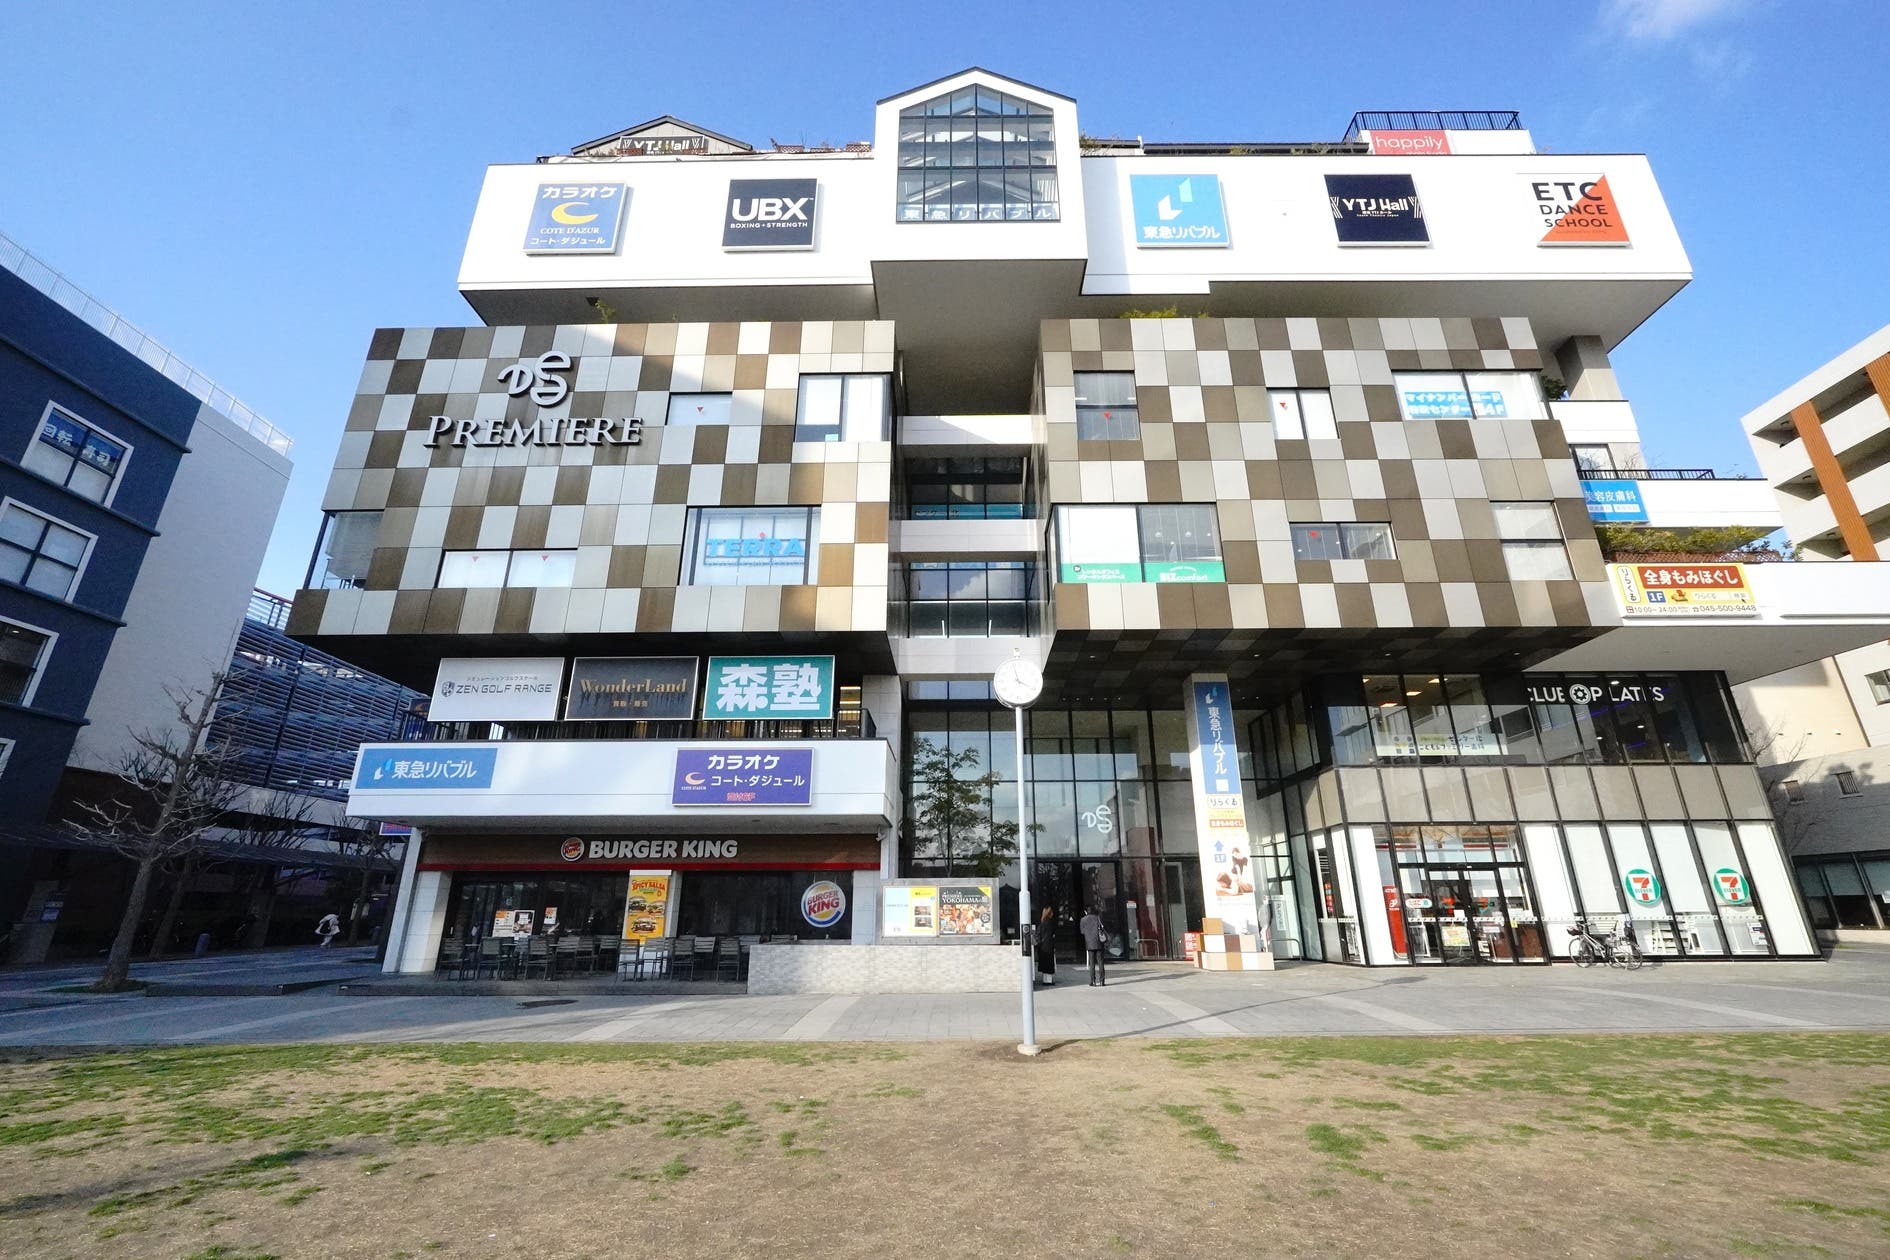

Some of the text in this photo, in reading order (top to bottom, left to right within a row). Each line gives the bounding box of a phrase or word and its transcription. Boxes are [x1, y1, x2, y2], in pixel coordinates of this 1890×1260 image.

[1375, 136, 1442, 150] happily
[542, 186, 617, 199] カラオケ
[1531, 182, 1603, 201] ETC
[732, 197, 808, 221] UBX
[1342, 198, 1409, 211] YTJ Hall
[1539, 204, 1609, 215] DANCE
[1544, 218, 1613, 227] SCHOOL
[1143, 225, 1221, 239] 東急リバブル
[422, 415, 644, 448] PREMIERE
[706, 538, 804, 557] TERRA
[1644, 569, 1738, 585] 全身もみほぐし
[1649, 593, 1664, 602] 1F
[456, 683, 552, 694] ZEN GOLF RANGE
[580, 678, 688, 693] WonderLand
[716, 663, 822, 711] 森塾
[1208, 706, 1228, 775] 東急リバブル
[391, 760, 477, 778] 東急リバブル
[708, 755, 780, 770] カラオケ
[711, 775, 805, 787] コート・ダジュール
[588, 840, 677, 859] BURGER
[682, 840, 738, 858] KING
[1632, 877, 1650, 900] 7
[1720, 876, 1739, 900] 7
[808, 897, 840, 916] KING
